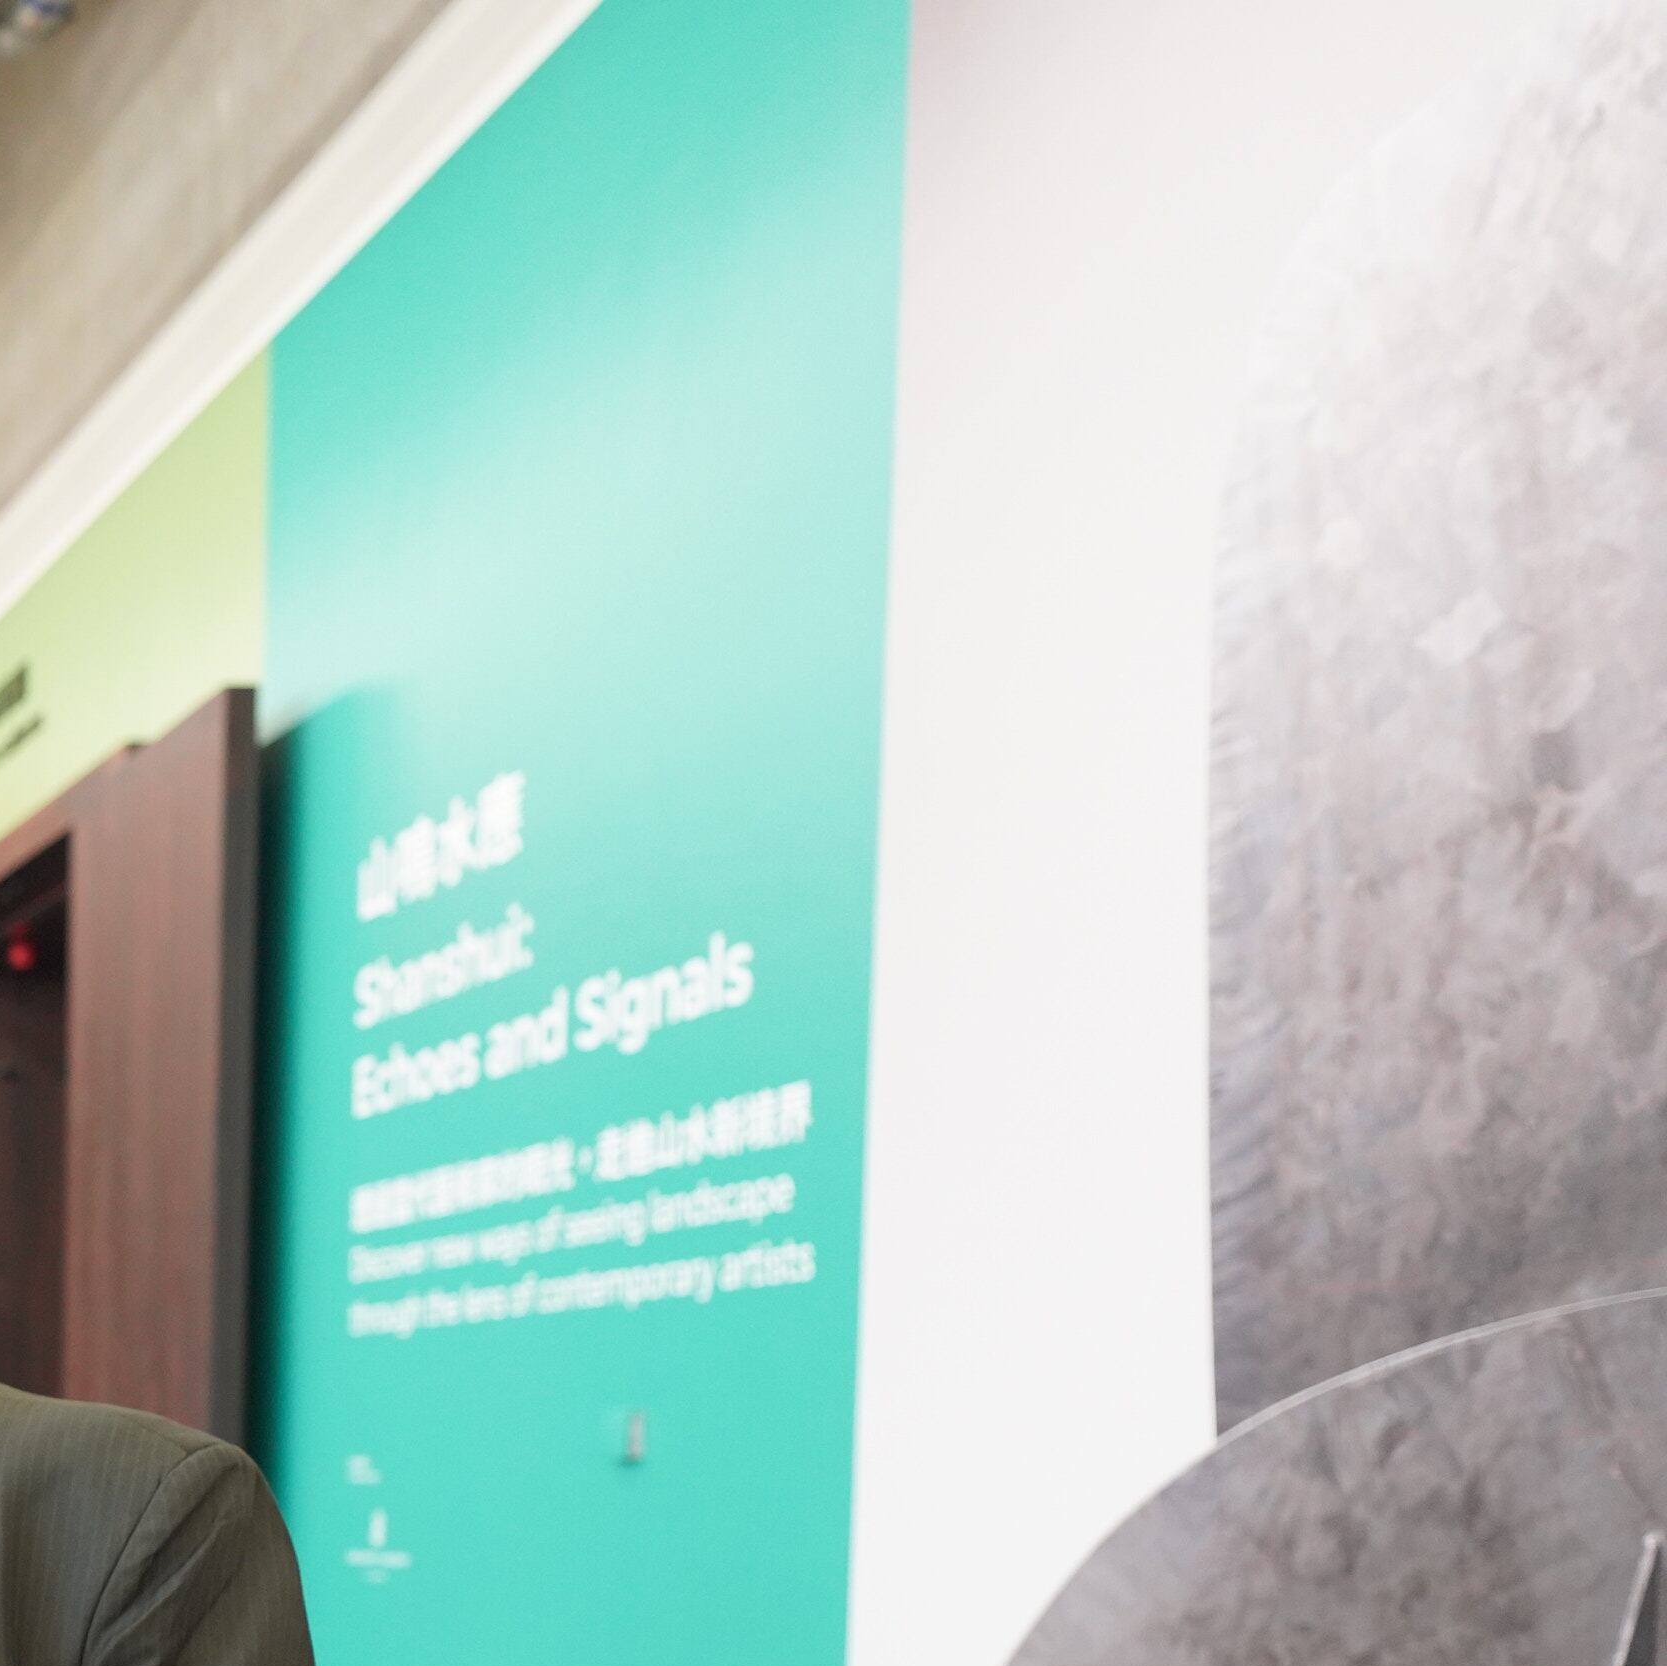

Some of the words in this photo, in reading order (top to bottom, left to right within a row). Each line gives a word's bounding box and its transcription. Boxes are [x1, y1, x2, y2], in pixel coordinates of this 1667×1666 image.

[354, 902, 534, 1030] Shanshui:
[351, 1032, 480, 1120] Echoes
[485, 985, 568, 1080] and
[574, 930, 755, 1054] Signals
[647, 1172, 796, 1235] landscape
[538, 1257, 716, 1314] contemporary
[718, 1239, 817, 1293] artists
